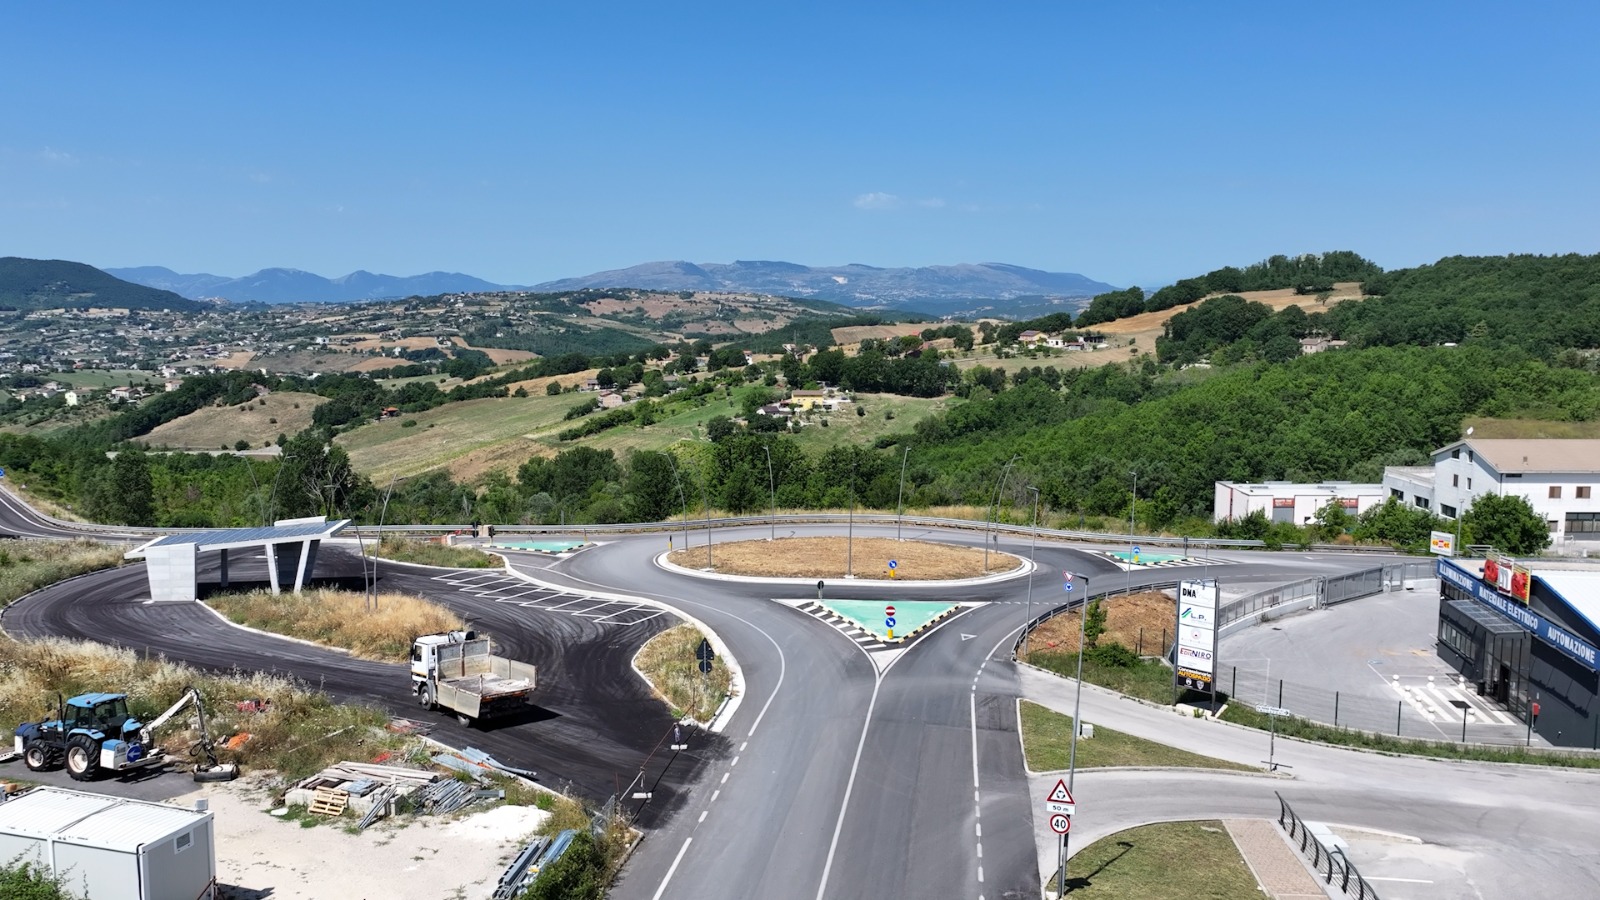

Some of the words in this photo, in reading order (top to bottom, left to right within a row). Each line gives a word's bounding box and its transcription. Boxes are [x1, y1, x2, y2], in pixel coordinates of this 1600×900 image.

[1439, 563, 1473, 592] ILLUMINAZIONE
[1182, 588, 1197, 598] DNA
[1479, 586, 1507, 612] MATERIALE
[1507, 602, 1538, 630] ELETTRICO
[1547, 626, 1595, 664] AUTOMAZIONE
[1054, 819, 1066, 829] 40
